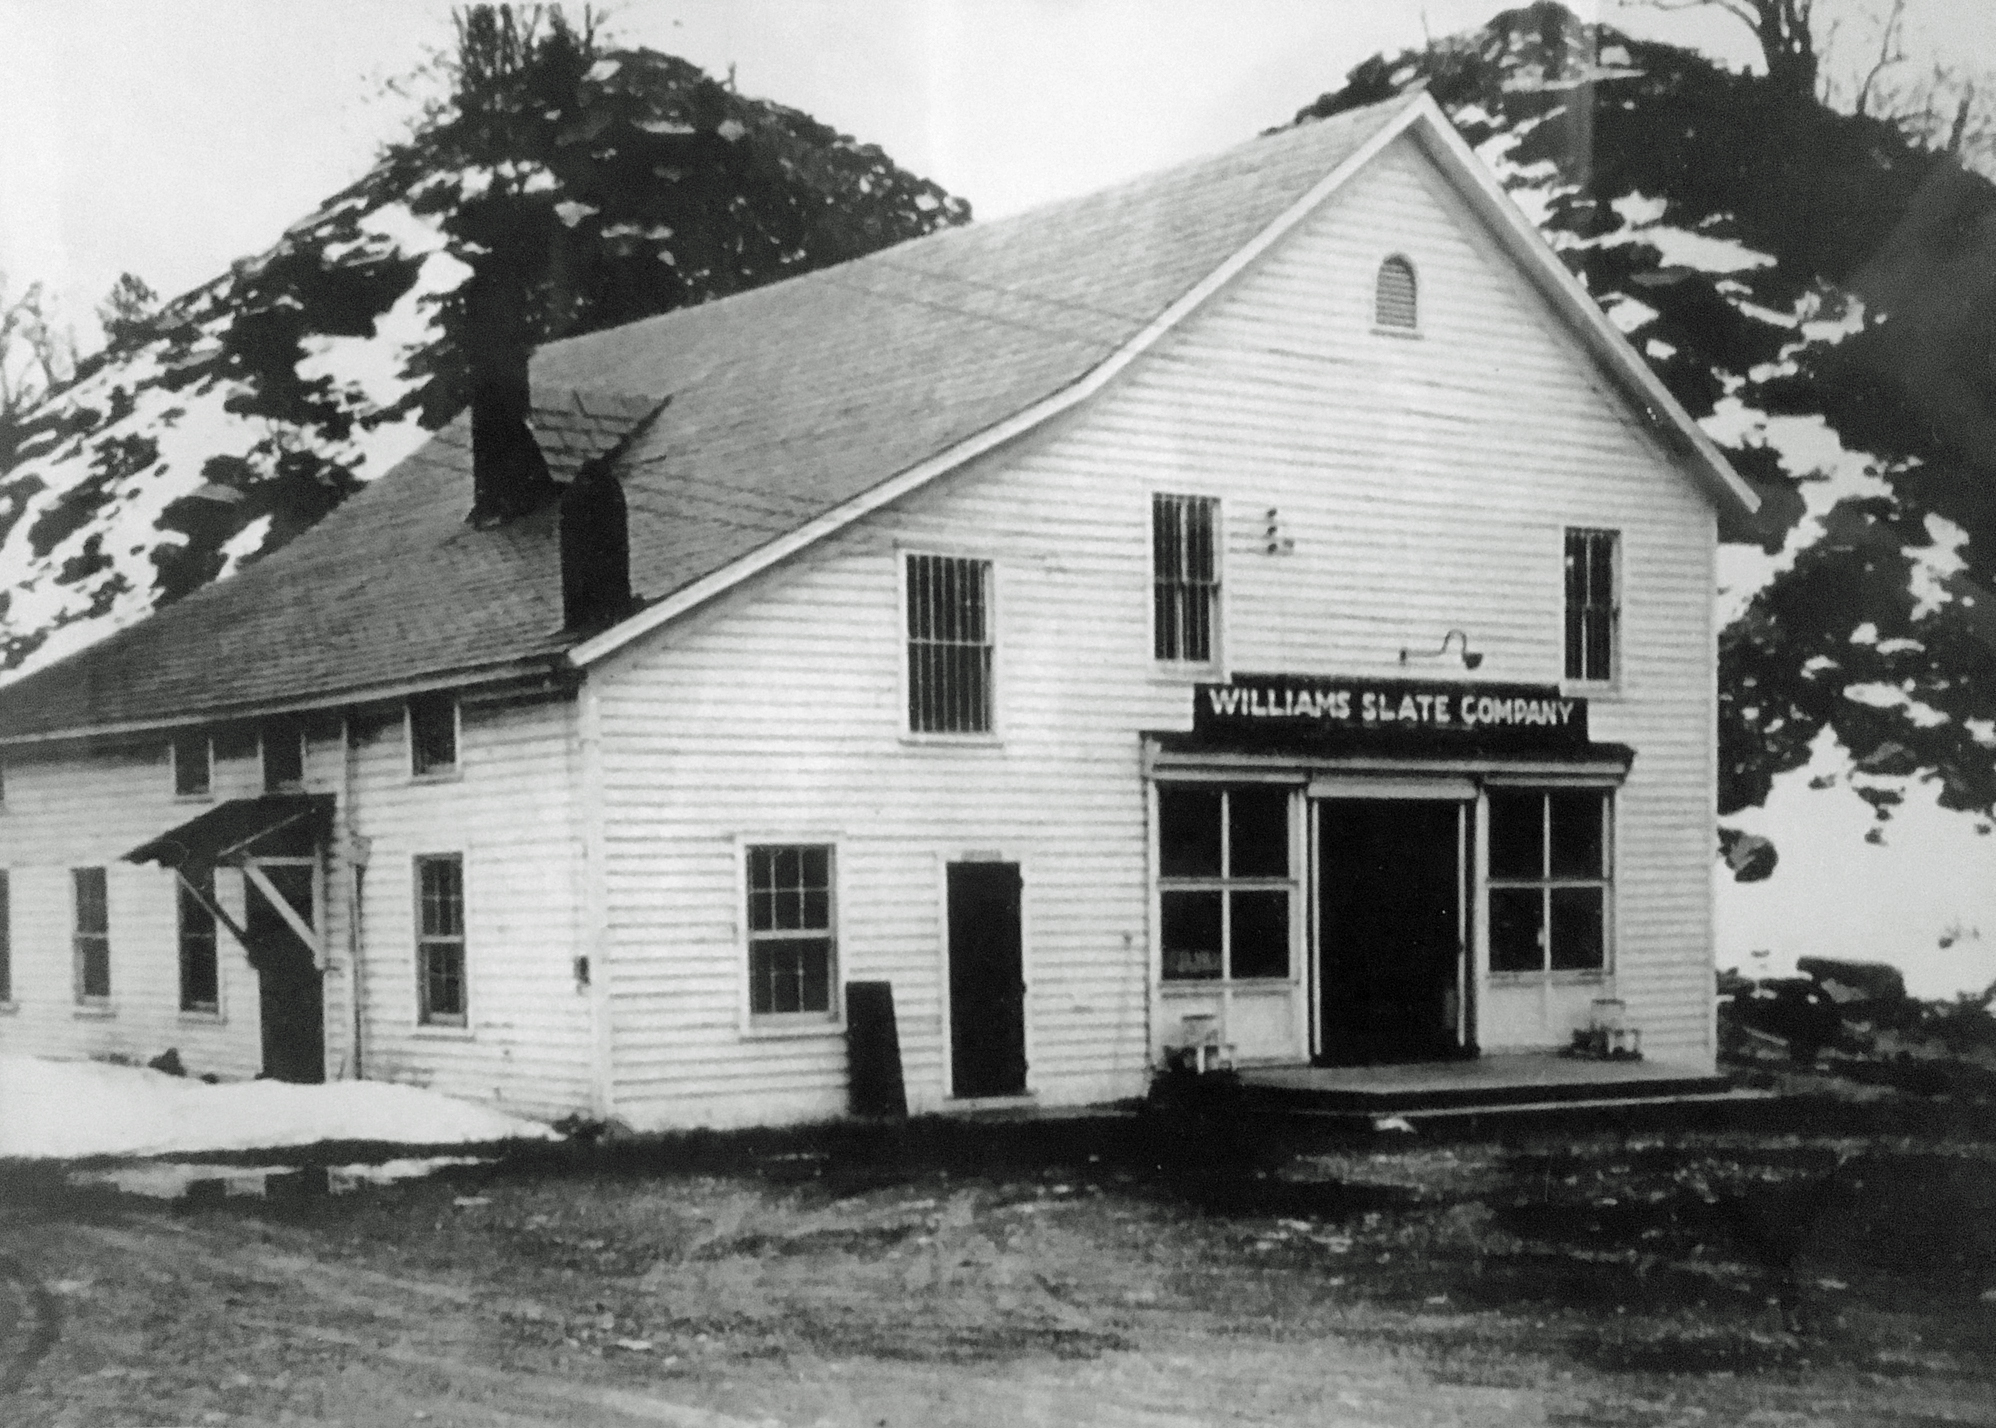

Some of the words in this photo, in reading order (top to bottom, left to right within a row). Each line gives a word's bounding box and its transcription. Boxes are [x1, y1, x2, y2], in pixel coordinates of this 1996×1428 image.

[1208, 688, 1351, 720] WILLIAMS
[1361, 691, 1450, 722] SLATE
[1460, 694, 1574, 725] COMPANY
